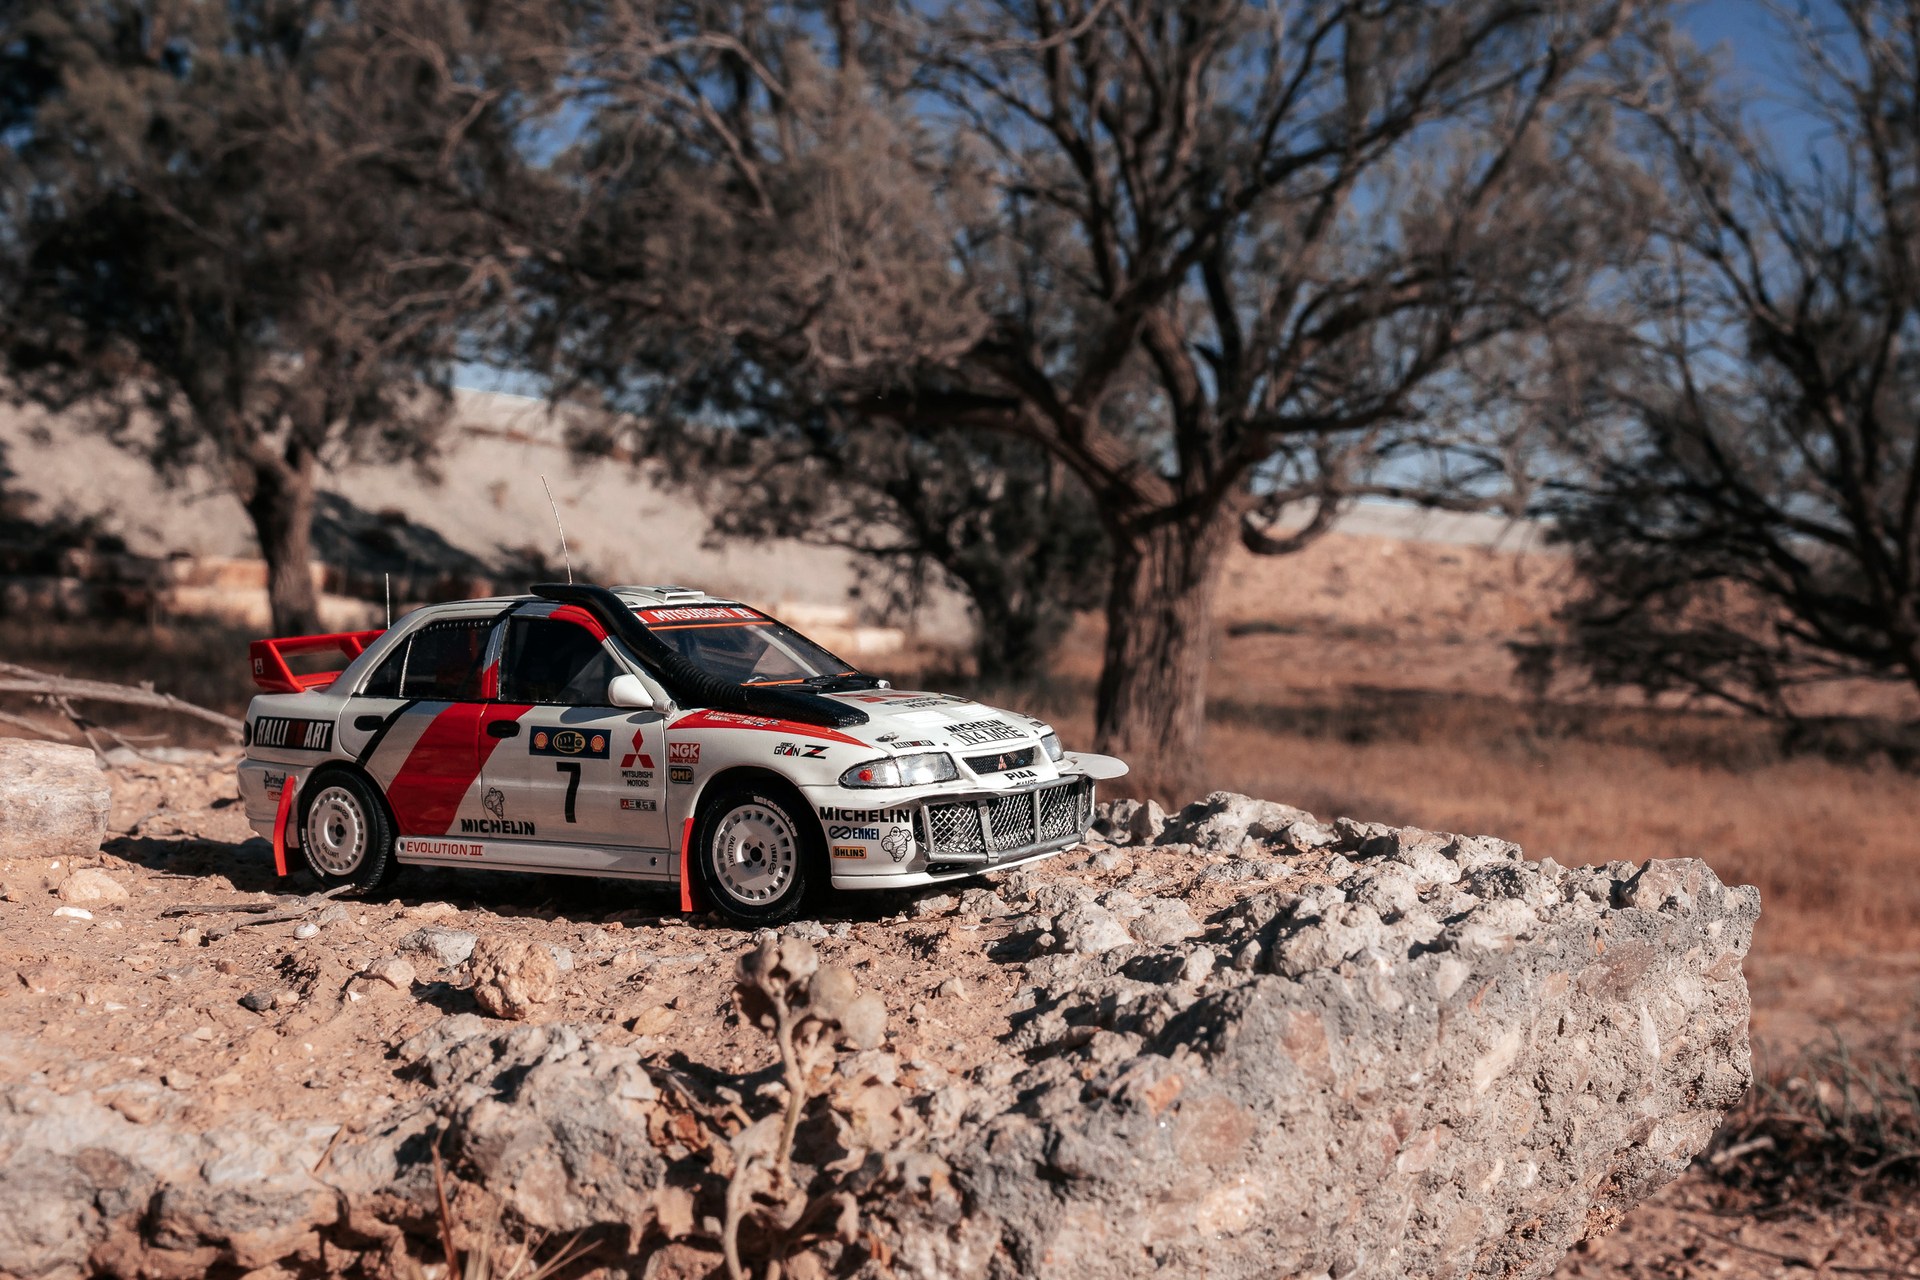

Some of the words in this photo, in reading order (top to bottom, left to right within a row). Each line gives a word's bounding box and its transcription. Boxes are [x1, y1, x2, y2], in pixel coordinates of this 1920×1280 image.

[650, 608, 735, 621] MITSUBISHI
[943, 719, 1006, 733] MICHELIN
[982, 726, 1025, 740] MRE
[256, 718, 290, 746] RALLI
[303, 721, 331, 749] ART
[670, 743, 699, 758] NGK
[801, 744, 830, 759] Z
[622, 770, 654, 779] MITSUBISHI
[671, 770, 692, 780] OMP
[1004, 770, 1038, 781] PIAA
[627, 779, 650, 787] MOTORS
[556, 761, 582, 823] 7
[819, 806, 910, 823] MICHELIN
[461, 818, 535, 836] MICHELIN
[852, 827, 880, 840] ENKEI
[406, 841, 468, 856] EVOLUTION
[834, 847, 865, 857] ÖHLINS
